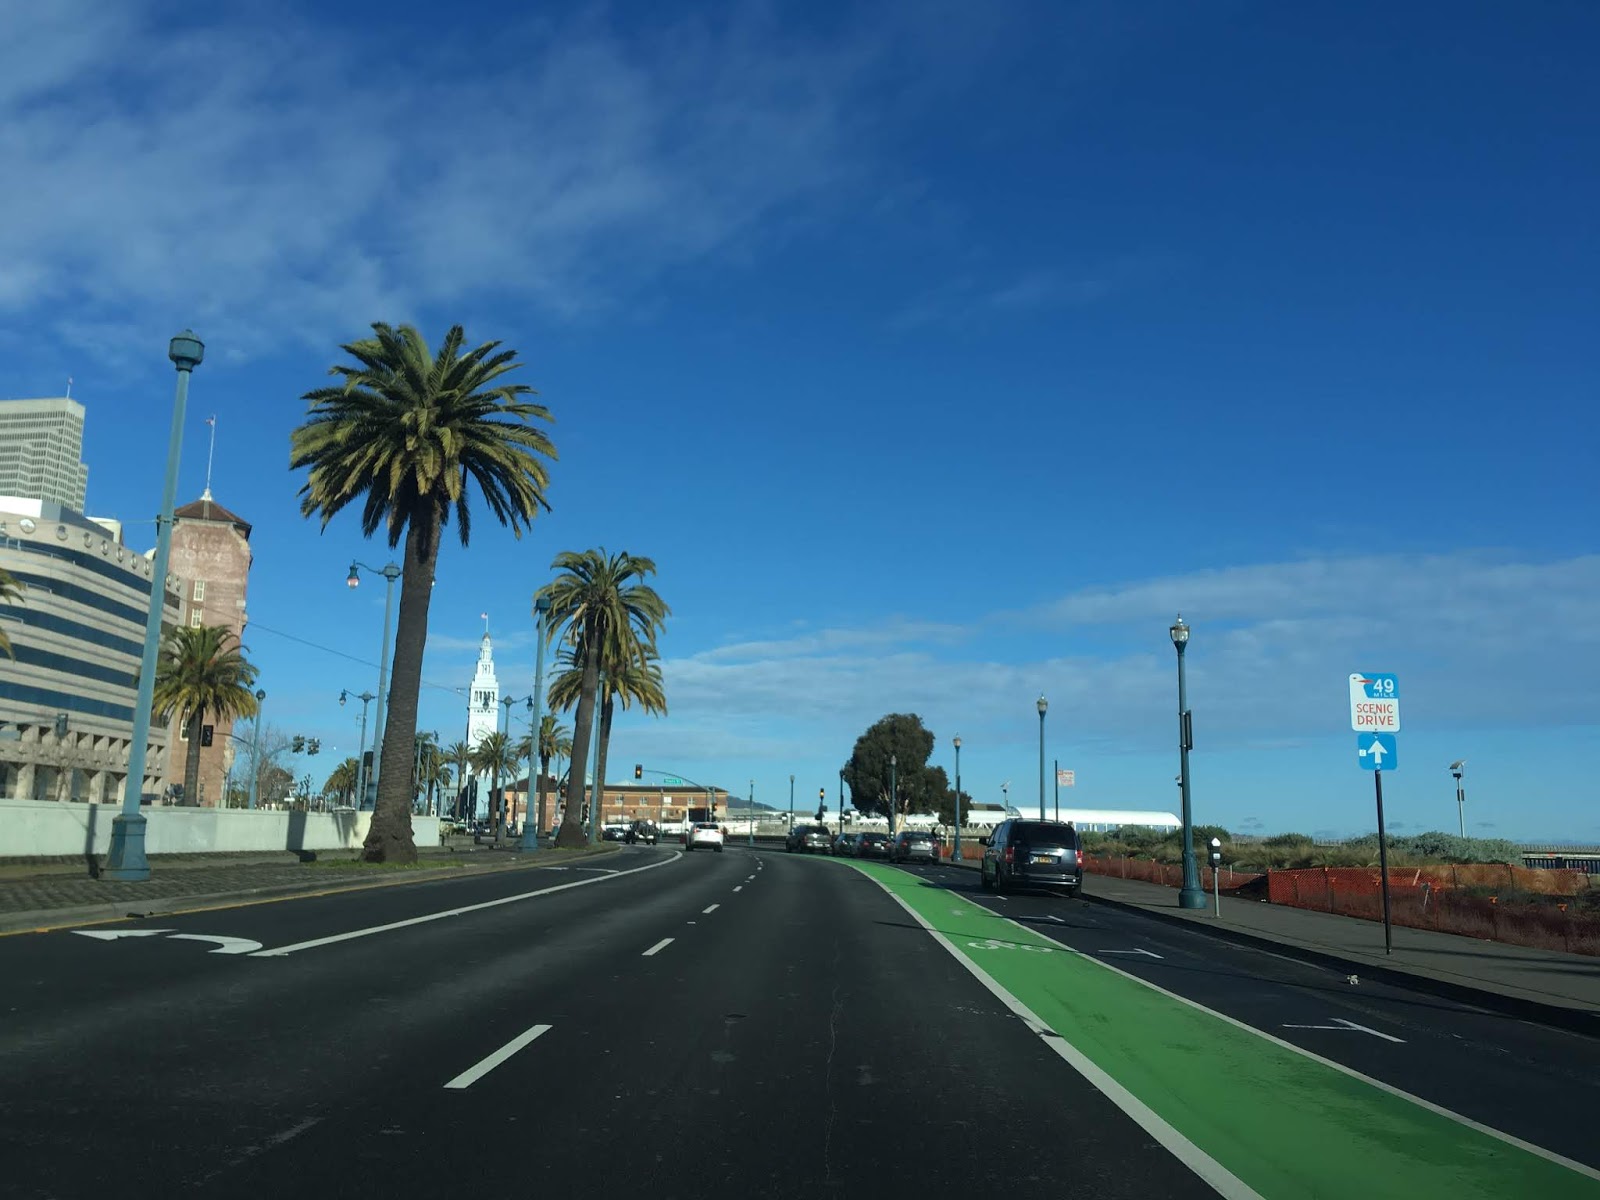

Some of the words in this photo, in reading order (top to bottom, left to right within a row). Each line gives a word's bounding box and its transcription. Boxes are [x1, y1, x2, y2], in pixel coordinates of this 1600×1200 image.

[1373, 678, 1394, 693] 49
[1356, 703, 1393, 714] SCENIC
[1357, 715, 1394, 725] DRIVE
